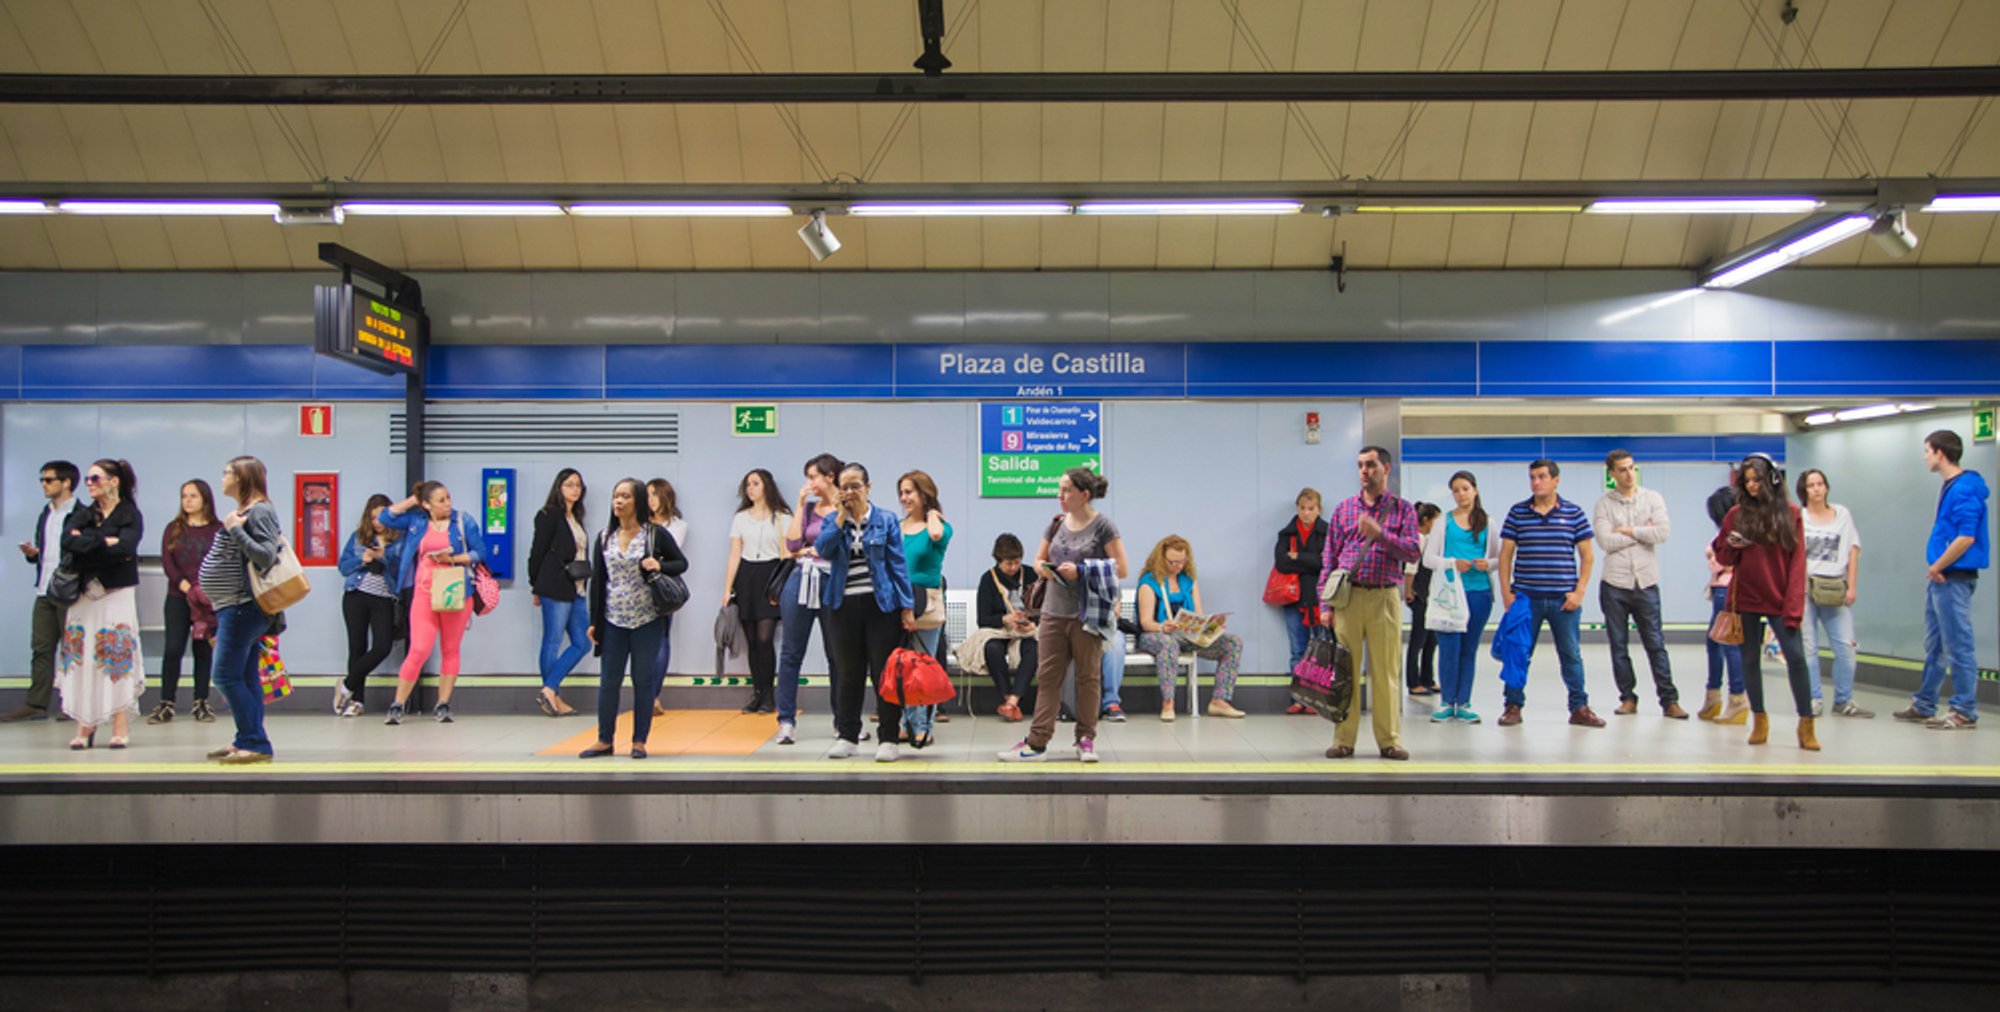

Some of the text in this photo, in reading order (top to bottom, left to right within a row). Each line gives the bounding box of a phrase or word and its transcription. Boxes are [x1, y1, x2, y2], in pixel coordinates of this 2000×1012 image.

[940, 352, 1145, 374] Plaza de Castilla
[1017, 386, 1062, 396] Andén 1
[1007, 407, 1015, 424] 1
[1007, 433, 1018, 450] 9
[1026, 431, 1068, 439] Mirasierra
[1056, 442, 1066, 450] del
[1068, 442, 1080, 453] Rey
[988, 455, 1039, 471] Salida
[987, 475, 1022, 483] Terminal
[1025, 475, 1035, 483] de
